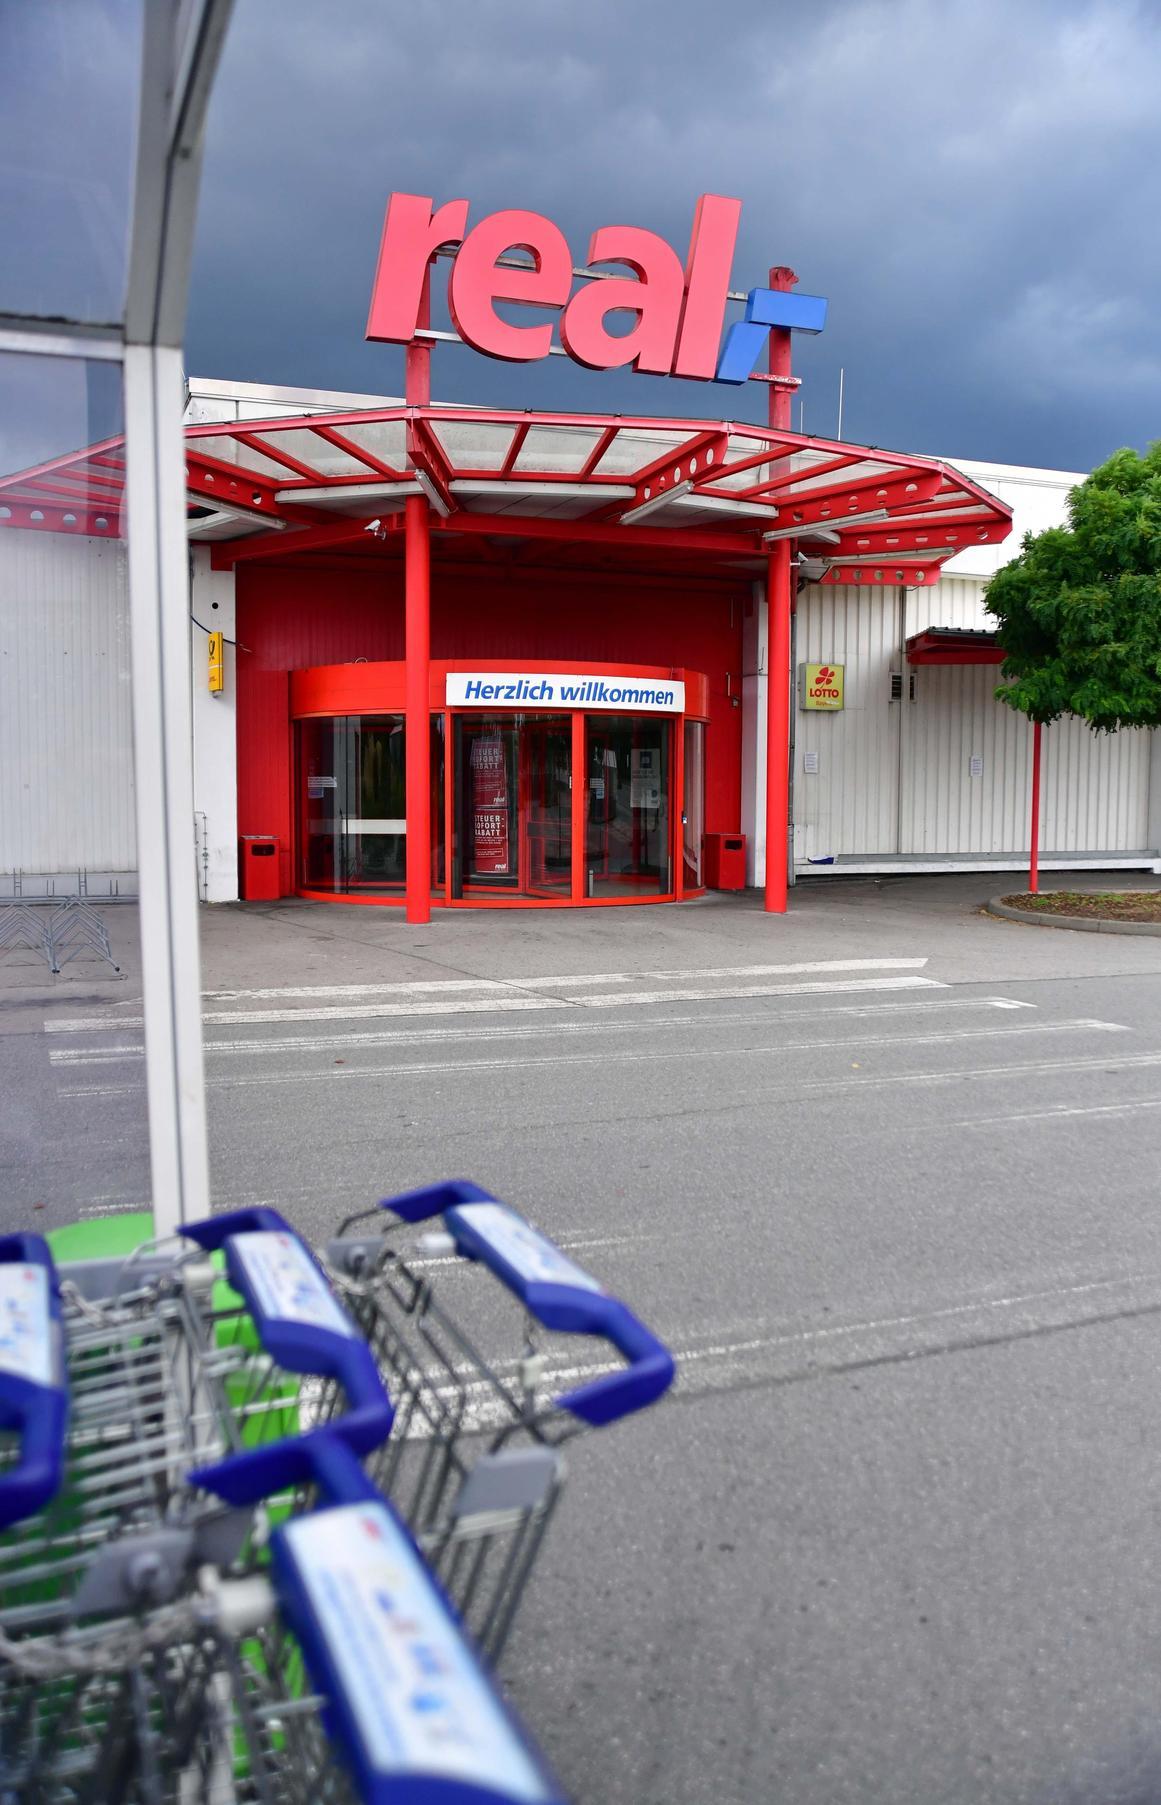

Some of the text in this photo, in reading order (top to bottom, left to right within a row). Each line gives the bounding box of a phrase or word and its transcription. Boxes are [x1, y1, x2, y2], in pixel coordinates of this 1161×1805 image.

[464, 679, 674, 705] Herzlich willkommen
[809, 688, 839, 698] LOTTO
[473, 748, 503, 756] EUER-
